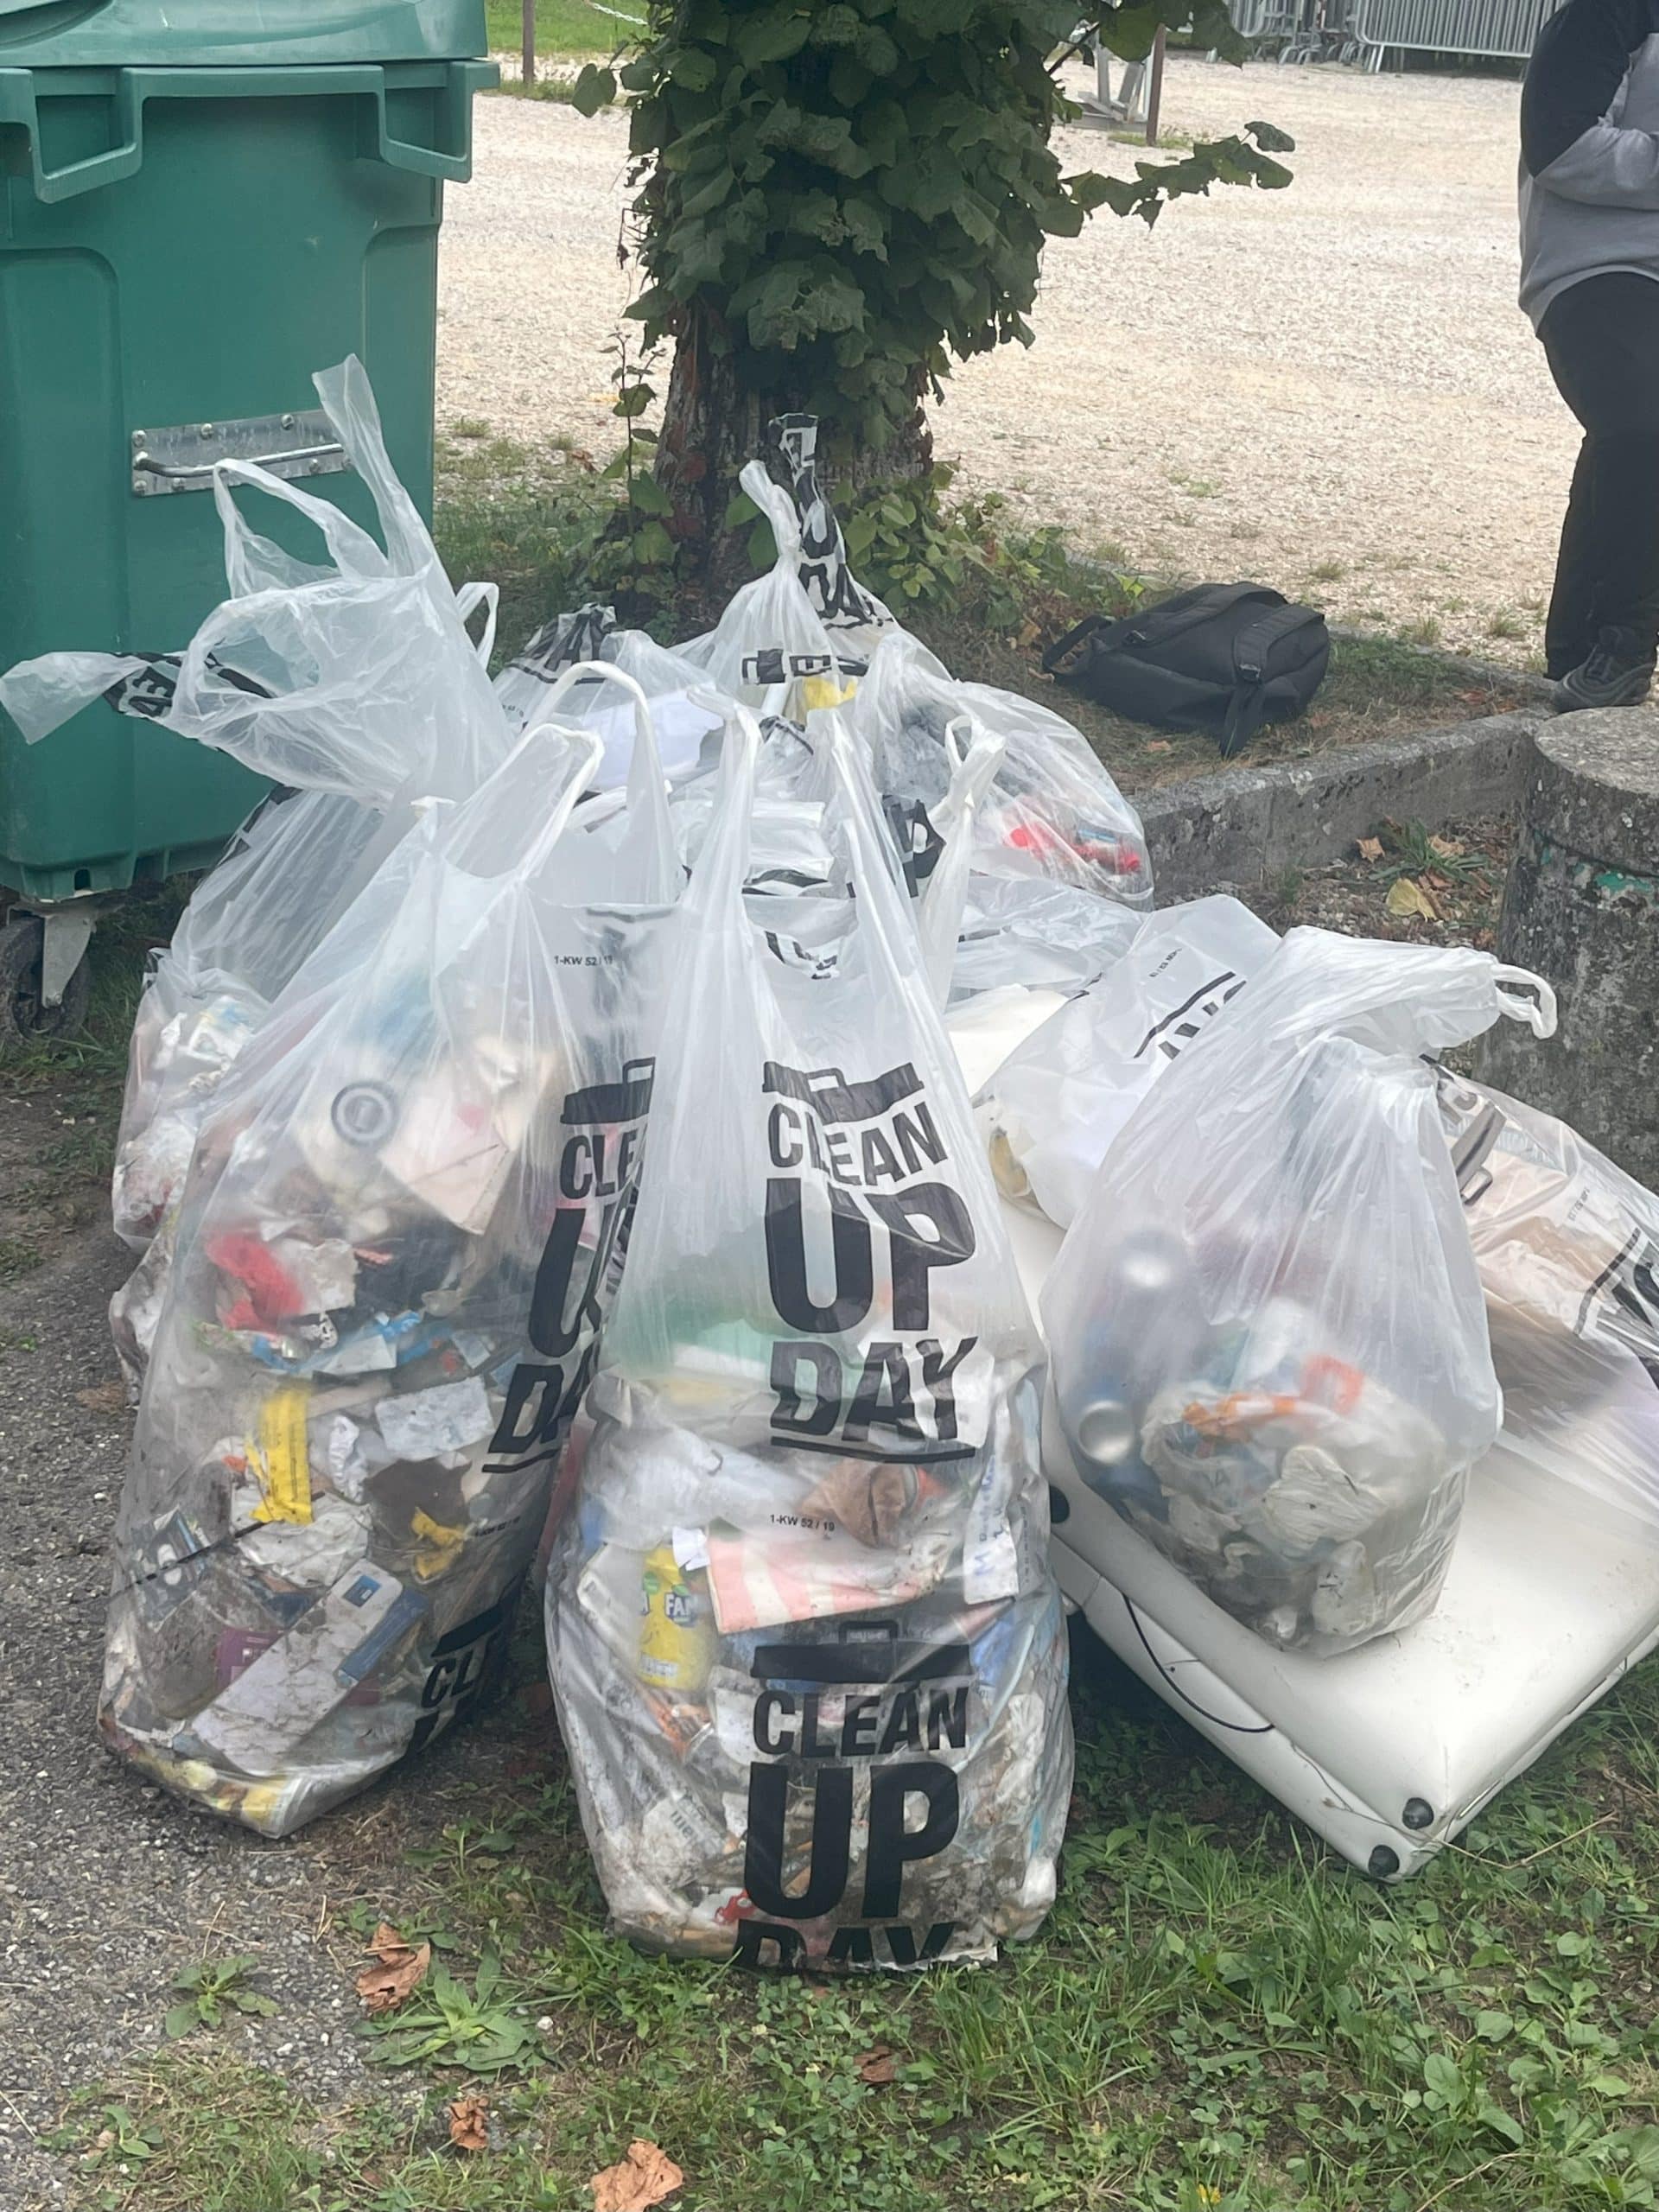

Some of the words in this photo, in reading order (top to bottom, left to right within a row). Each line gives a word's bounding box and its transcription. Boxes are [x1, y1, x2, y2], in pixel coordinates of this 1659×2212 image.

[554, 955, 582, 965] 1-KW
[585, 957, 598, 966] 52
[768, 1101, 948, 1185] CLEAN
[765, 1178, 976, 1333] UP
[770, 1336, 978, 1441] DAY
[770, 1514, 798, 1526] 1-KW
[823, 1522, 836, 1532] 19
[753, 1686, 969, 1758] CLEAN
[744, 1761, 959, 1919] UP
